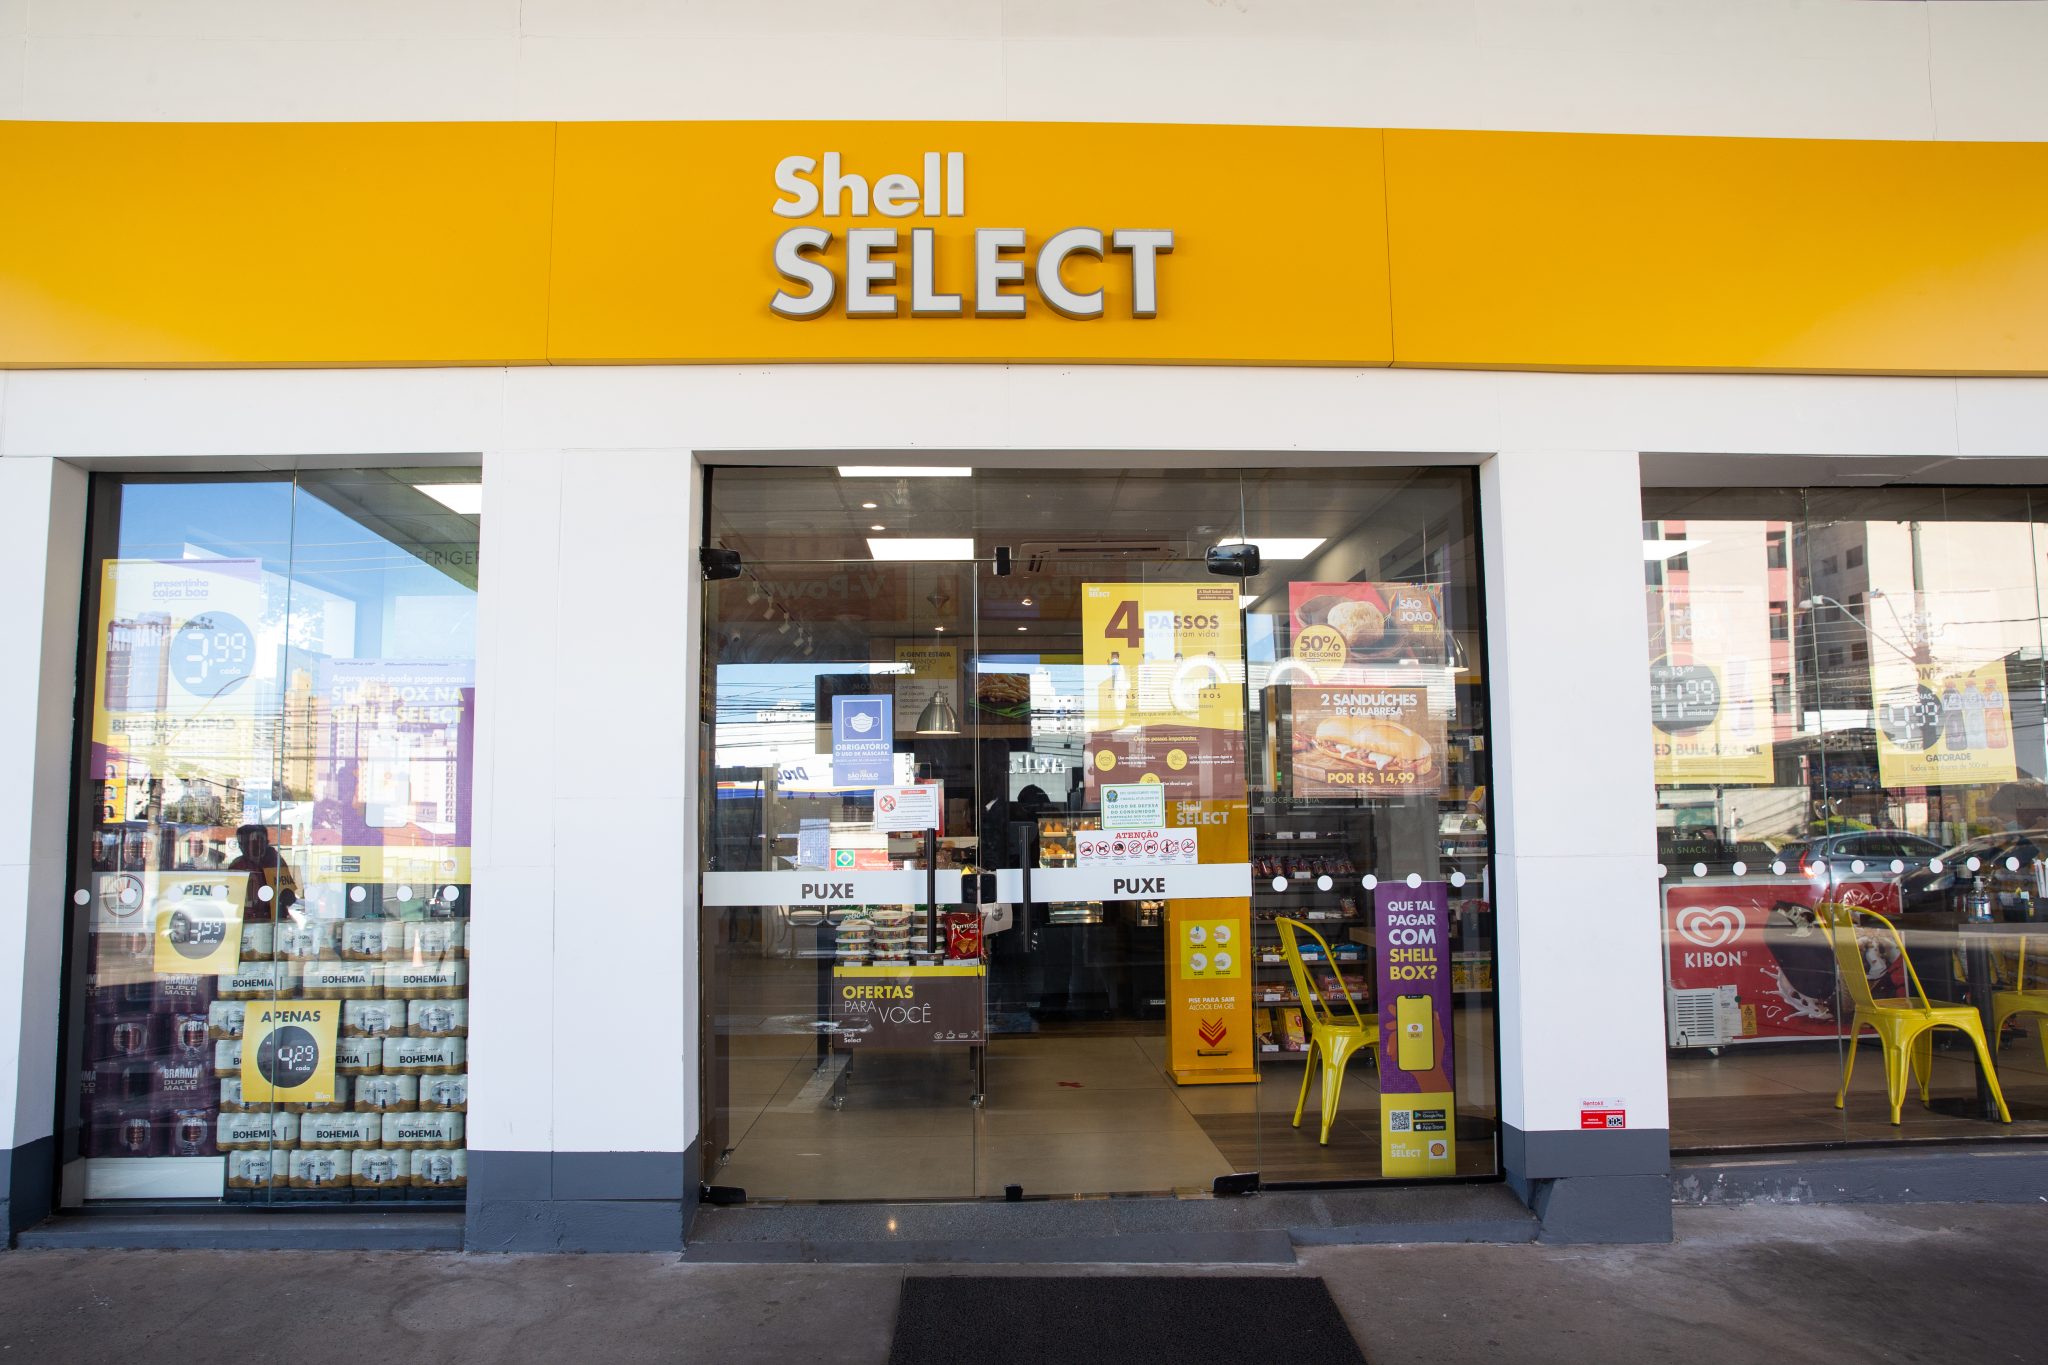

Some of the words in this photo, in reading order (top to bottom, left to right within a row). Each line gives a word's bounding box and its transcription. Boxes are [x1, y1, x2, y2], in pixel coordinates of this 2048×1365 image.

[773, 152, 965, 219] Shell
[769, 226, 1175, 320] SELECT
[153, 588, 181, 598] coisa
[185, 588, 209, 598] boa
[1400, 598, 1422, 609] SÃO
[1400, 610, 1432, 622] JOÃO
[1104, 600, 1144, 648] 4
[1148, 615, 1220, 630] PASSOS
[1167, 629, 1195, 638] salvam
[1198, 629, 1220, 637] vidas
[1300, 635, 1341, 652] 50%
[185, 633, 247, 685] 3,99
[220, 667, 241, 675] cada
[332, 674, 362, 686] Agora
[366, 674, 386, 683] você
[388, 675, 412, 683] pode
[414, 675, 444, 687] pagar
[446, 675, 467, 683] com
[394, 687, 430, 701] BOX
[434, 686, 464, 701] NA
[1320, 693, 1330, 706] 2
[1333, 691, 1417, 706] SANDUÍCHES
[396, 706, 465, 724] SELECT
[1335, 707, 1347, 715] DE
[1349, 707, 1403, 716] CALABRESA
[835, 742, 890, 751] OBRIGATÓRIO
[1676, 743, 1709, 755] BULL
[1925, 753, 1972, 763] GATORADE
[1327, 773, 1354, 784] POR
[1358, 772, 1374, 785] R$
[1379, 772, 1415, 785] 14,99
[1176, 801, 1202, 811] Shell
[1176, 812, 1230, 825] SELECT
[1115, 830, 1159, 841] ATENÇÃO
[1661, 847, 1674, 855] UM
[1724, 845, 1742, 853] SEU
[801, 882, 854, 899] PUXE
[1114, 877, 1166, 894] PUXE
[1387, 901, 1413, 912] QUE
[1415, 900, 1436, 911] TAL
[1388, 914, 1436, 926] PAGAR
[951, 922, 978, 931] Doritos
[1388, 928, 1437, 945] COM
[1390, 948, 1438, 963] SHELL
[1684, 950, 1742, 968] KIBON
[1390, 964, 1438, 980] BOX?
[165, 976, 197, 985] BRAHMA
[232, 979, 274, 988] BOHEMIA
[321, 975, 366, 984] BOHEMIA
[403, 975, 447, 984] BOHEMIA
[842, 985, 914, 999] OFERTAS
[261, 1010, 321, 1023] APENAS
[844, 1000, 876, 1013] PARA
[878, 1002, 932, 1024] VOCÊ
[277, 1045, 314, 1070] 4,29
[399, 1055, 444, 1063] BOHEMIA
[164, 1069, 198, 1079] BRAHMA
[232, 1129, 277, 1138] BOHEMIA
[316, 1129, 360, 1138] BOHEMIA
[398, 1129, 442, 1138] BOHEMIA
[1391, 1149, 1421, 1157] SELECT
